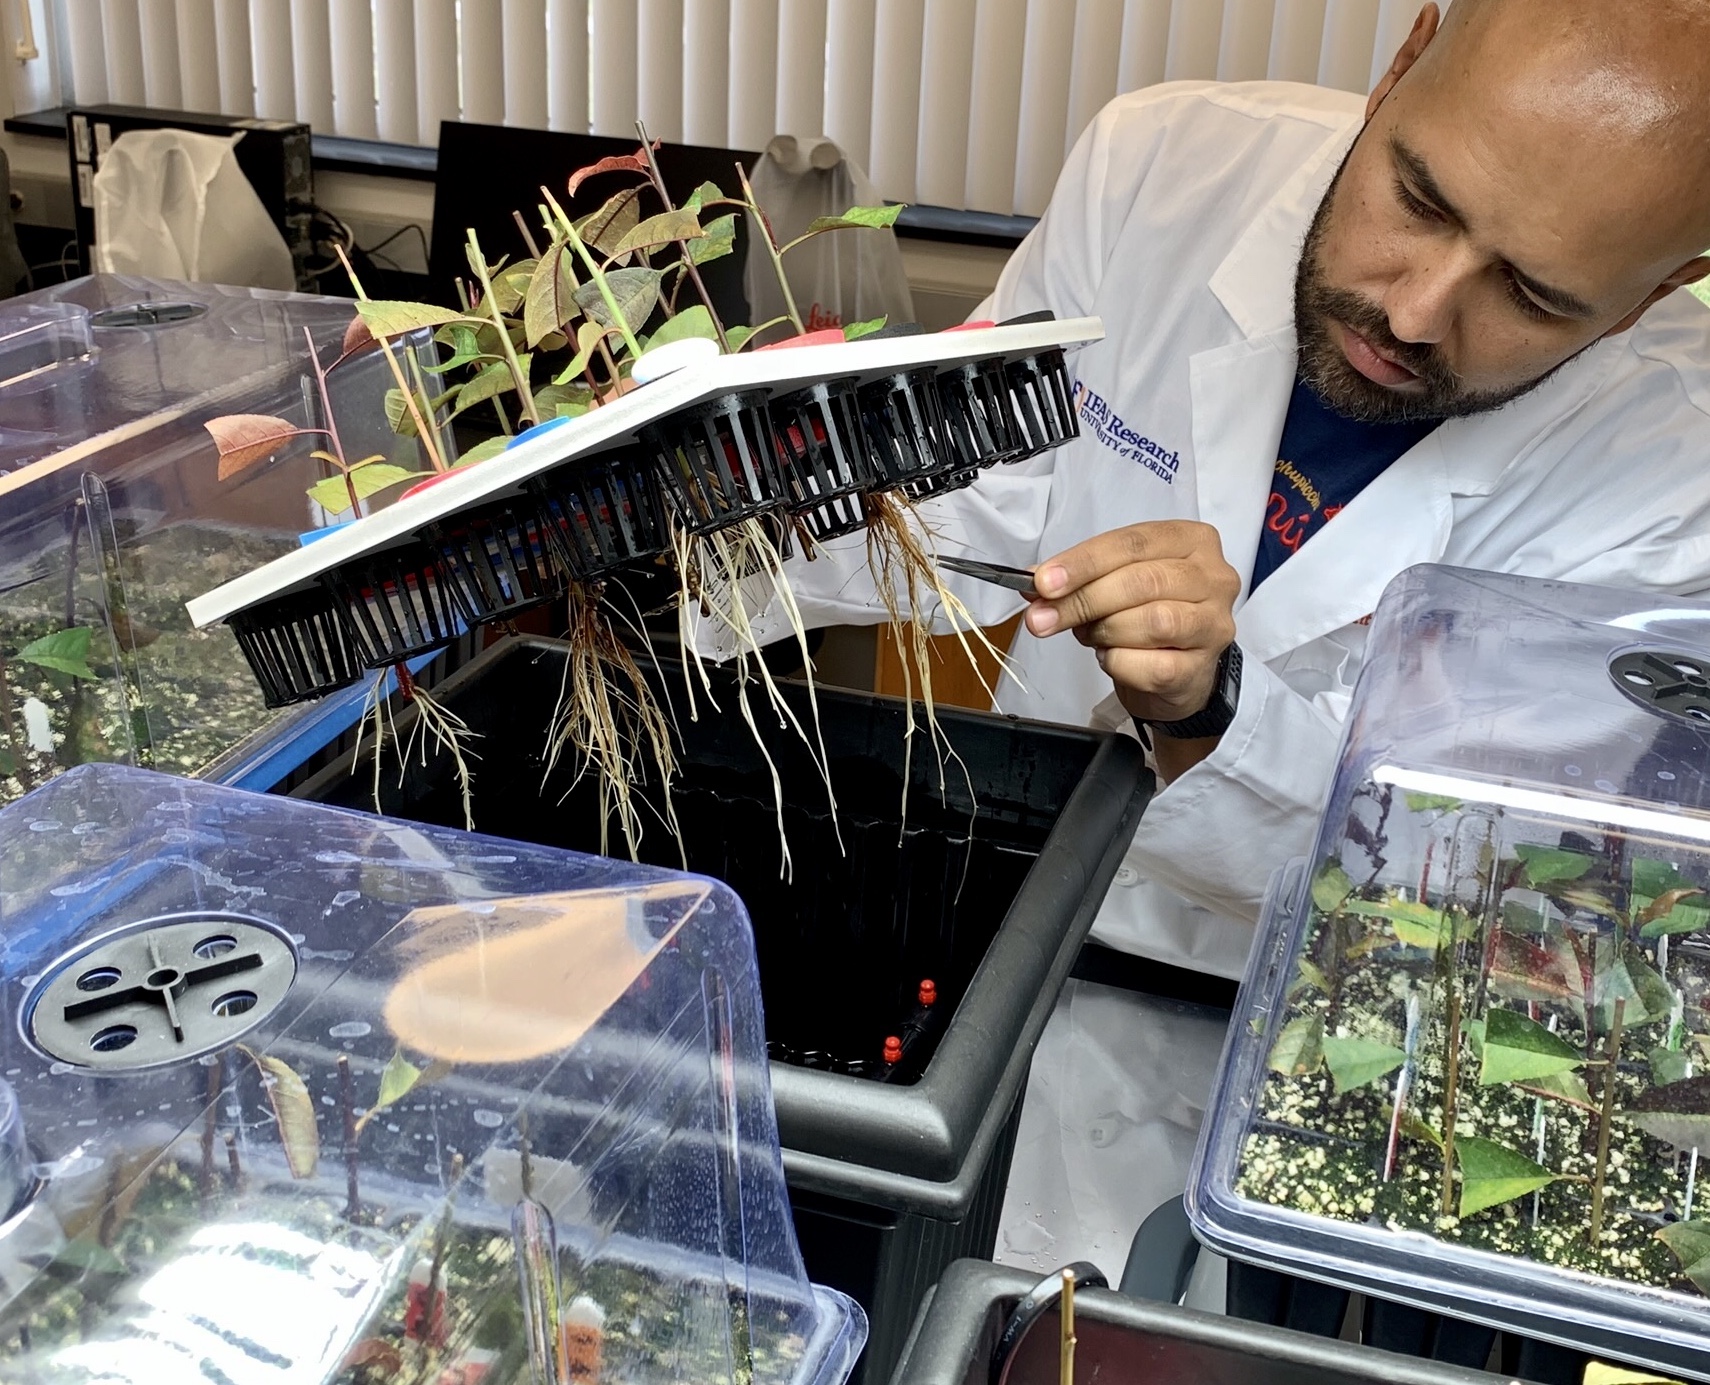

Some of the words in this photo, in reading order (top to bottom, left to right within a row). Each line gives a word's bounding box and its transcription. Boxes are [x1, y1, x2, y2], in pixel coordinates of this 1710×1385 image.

[1083, 389, 1112, 425] IFAS
[1106, 414, 1180, 473] Research
[1119, 447, 1133, 457] of
[1131, 450, 1173, 485] FLORIDA
